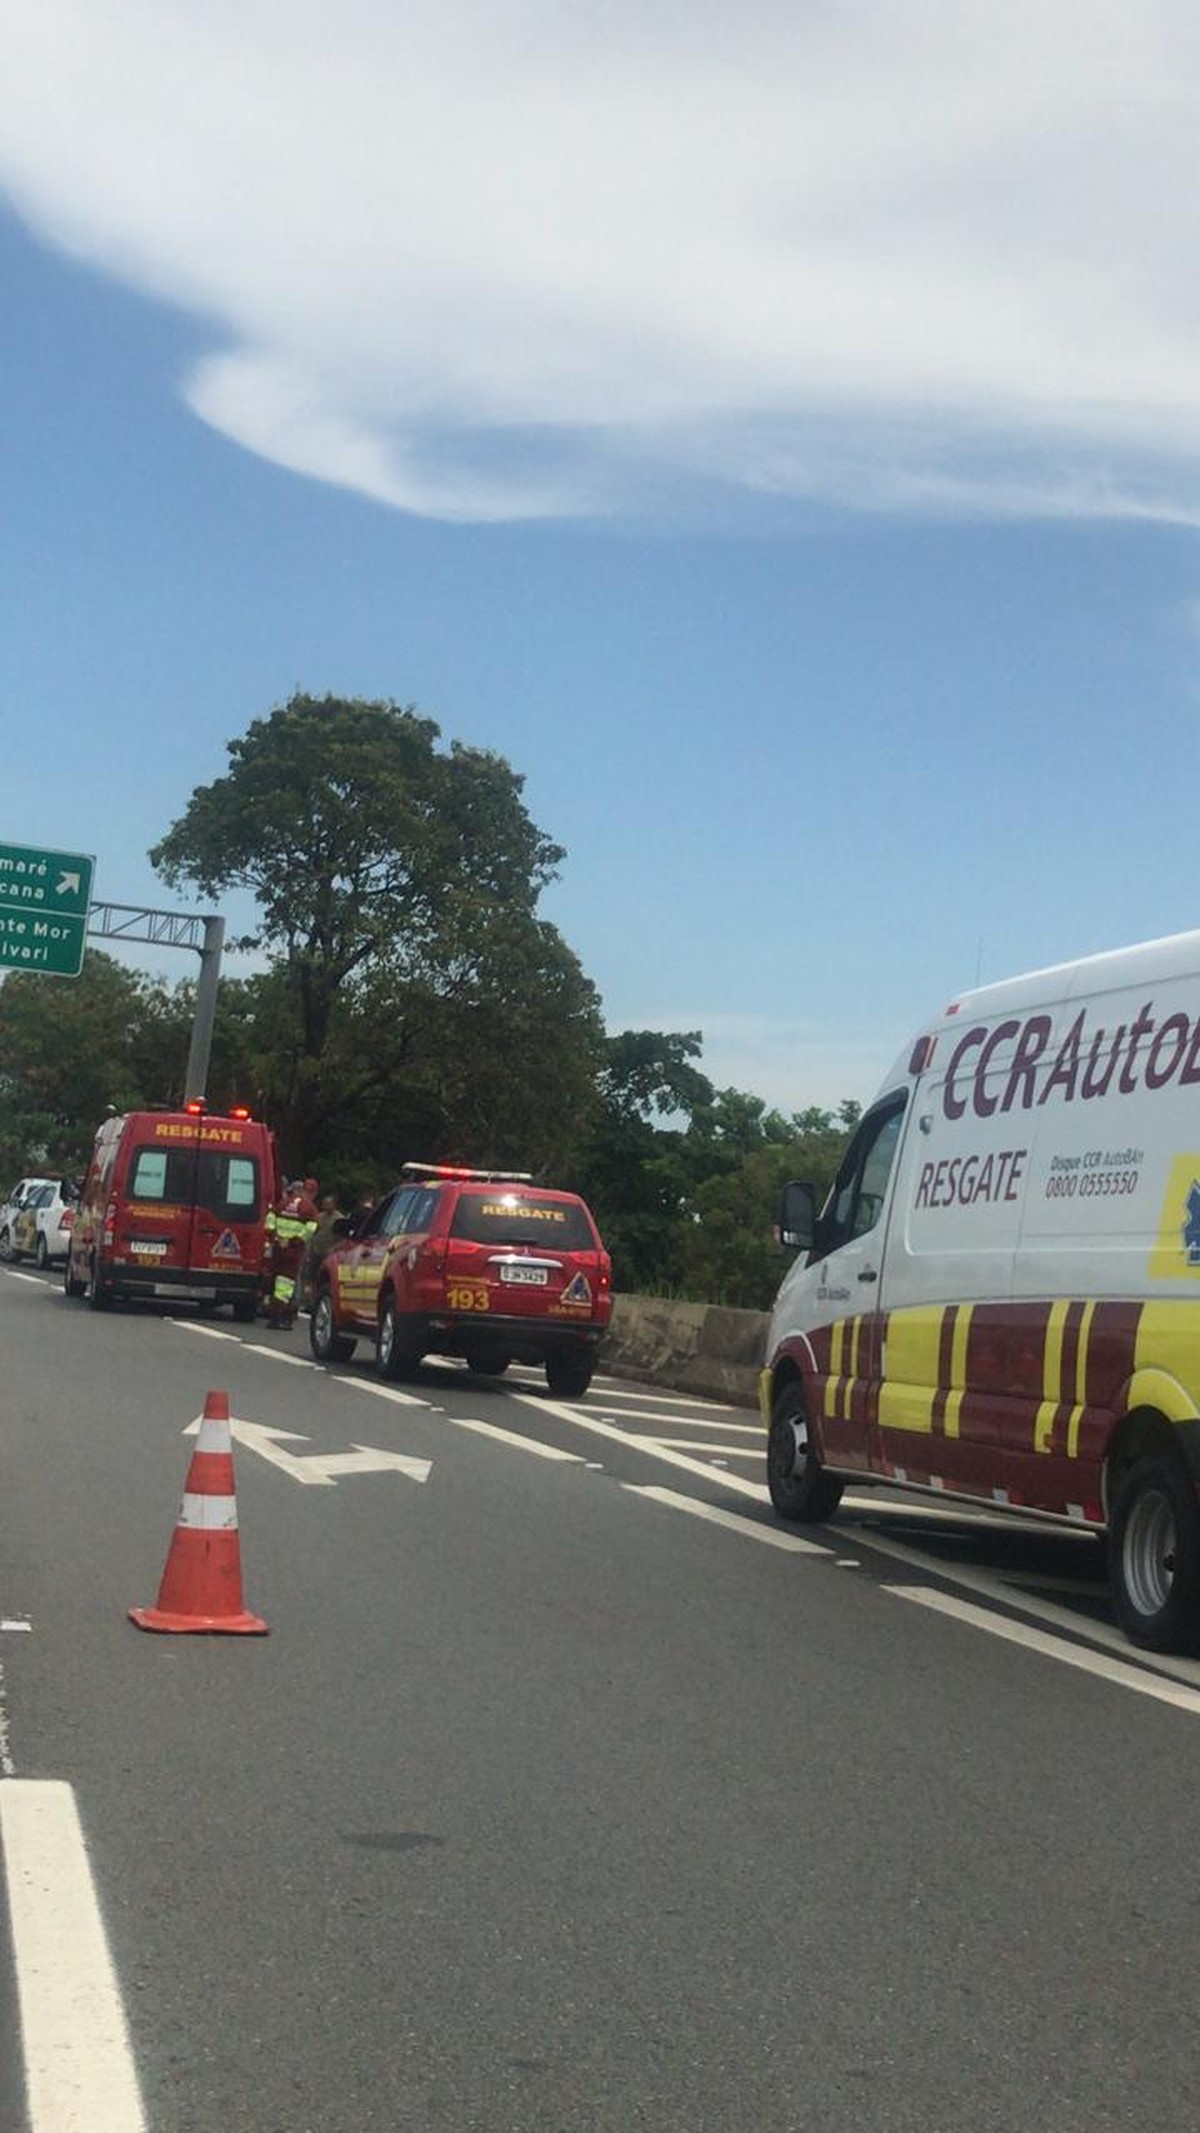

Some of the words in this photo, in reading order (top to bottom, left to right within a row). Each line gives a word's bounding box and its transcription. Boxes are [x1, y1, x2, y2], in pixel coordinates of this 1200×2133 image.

[0, 858, 47, 876] maré
[0, 882, 45, 899] cana
[34, 922, 71, 940] Mor
[155, 1123, 243, 1143] RESGATE
[1083, 1150, 1102, 1169] CCR
[914, 1148, 1028, 1210] RESGATE
[1045, 1174, 1078, 1199] 0800
[1079, 1170, 1138, 1197] 0555550
[482, 1204, 566, 1222] RESGATE
[447, 1288, 490, 1311] 193
